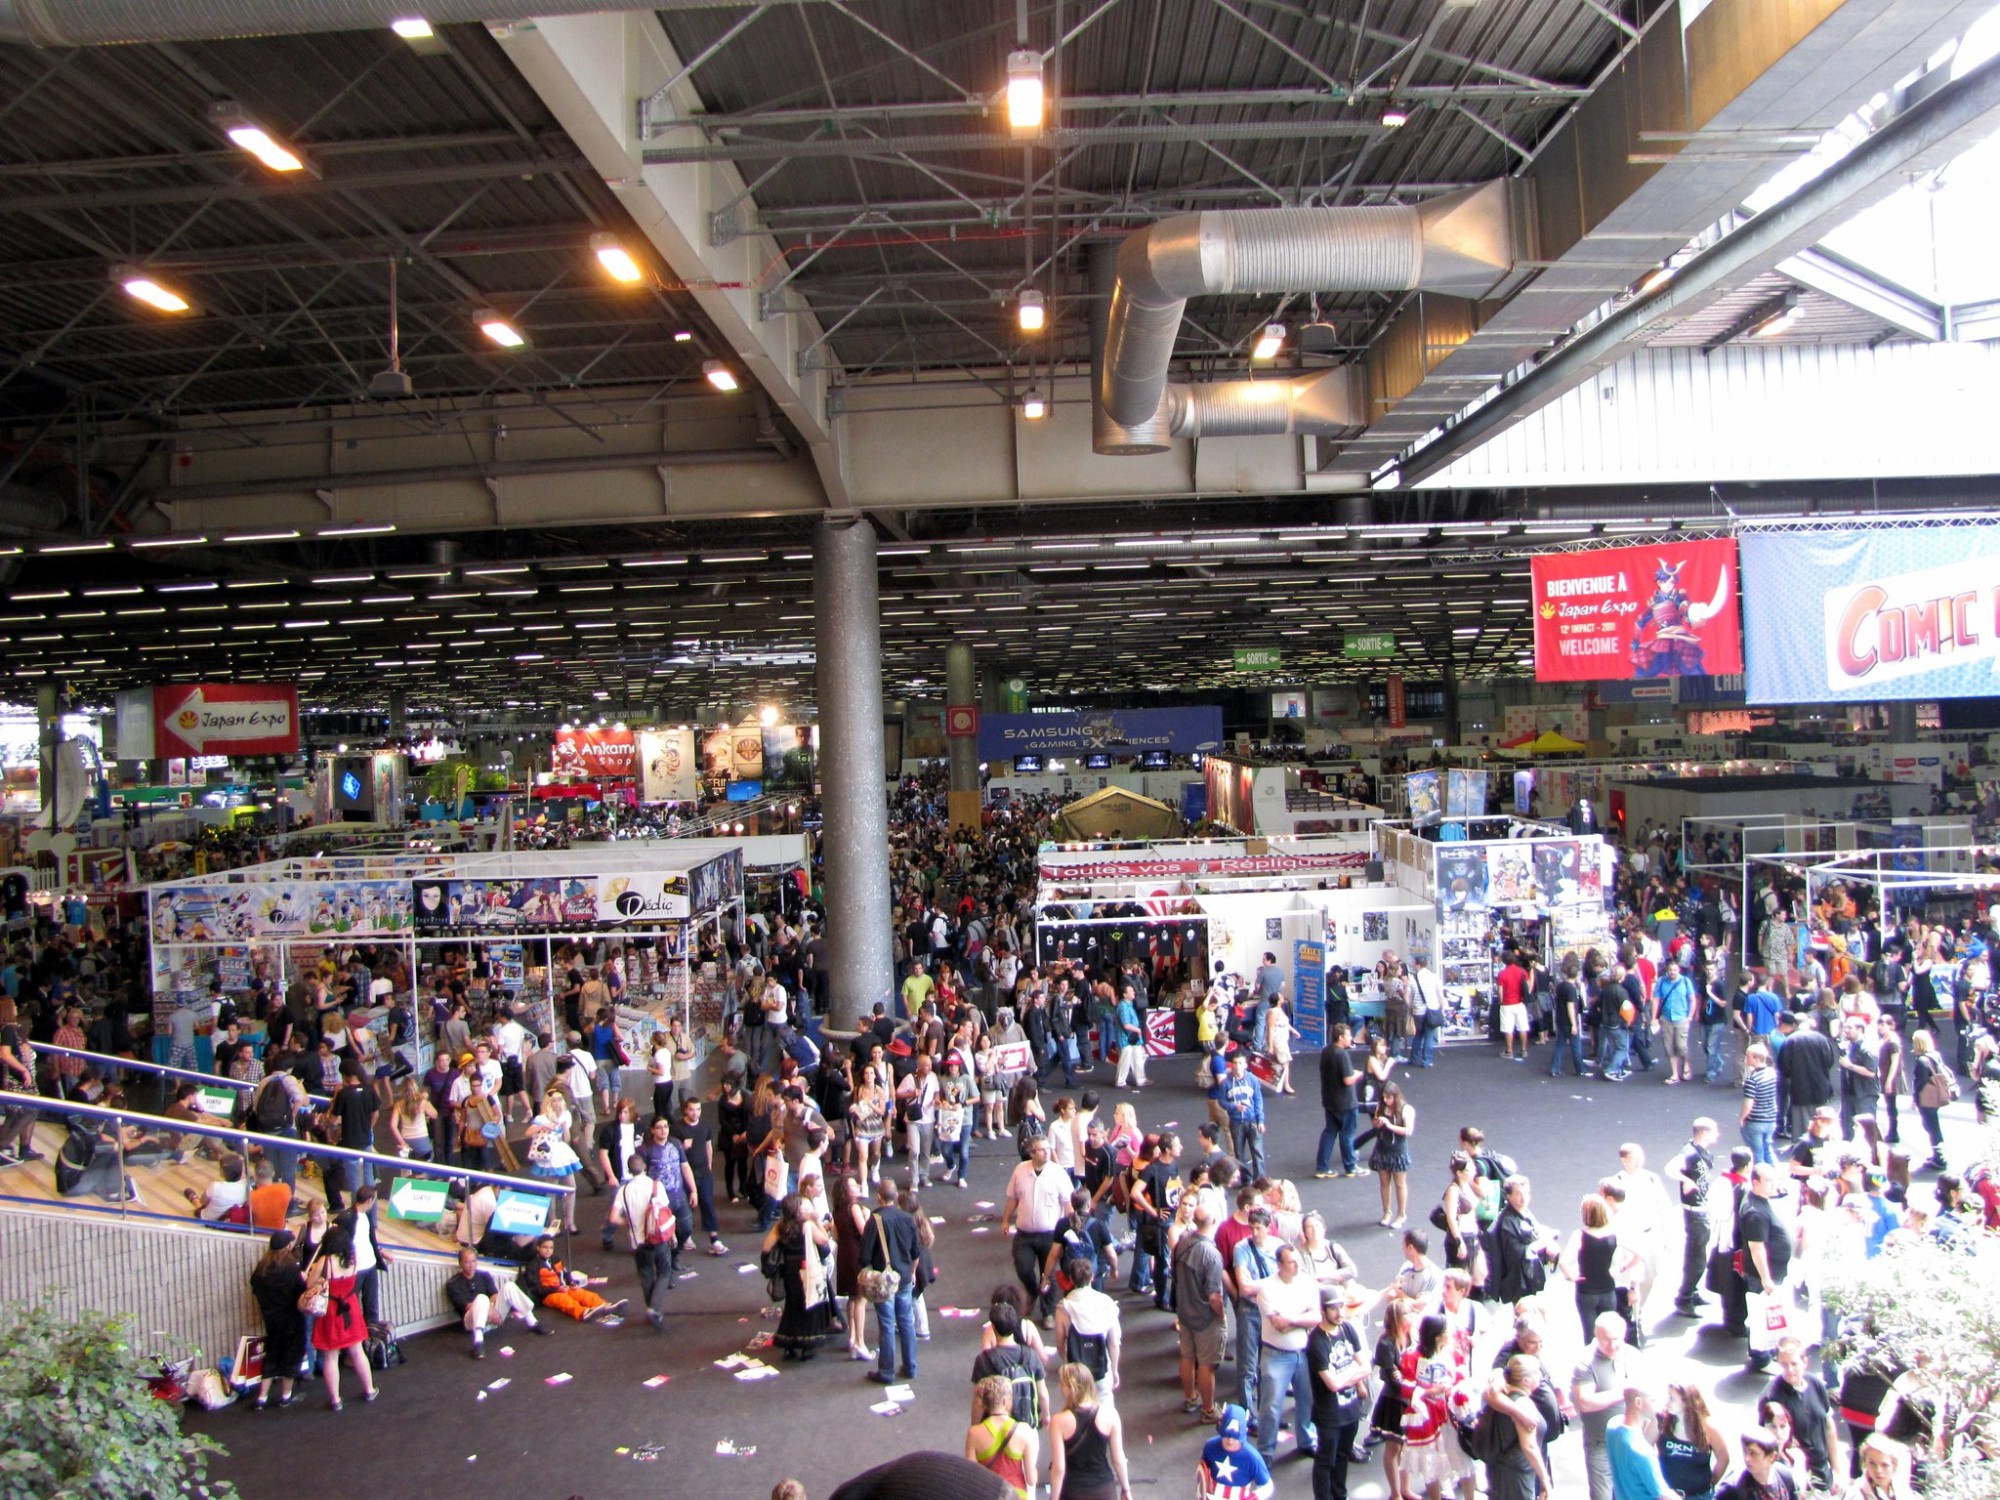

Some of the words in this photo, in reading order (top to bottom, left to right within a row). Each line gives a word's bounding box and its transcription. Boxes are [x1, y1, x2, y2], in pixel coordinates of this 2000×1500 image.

[1547, 575, 1616, 597] BIENVENUE
[1618, 572, 1628, 592] À
[1558, 602, 1598, 619] Japan
[1601, 599, 1638, 616] Expo
[1571, 623, 1595, 633] IMPACT
[1838, 585, 1979, 677] COMIC
[1358, 637, 1382, 651] SORTIE
[1559, 637, 1620, 656] WELCOME
[1246, 652, 1269, 665] SORTIE
[202, 711, 244, 729] Japan
[249, 711, 286, 727] Expo
[1004, 726, 1093, 738] SAMSUNG
[1030, 739, 1077, 748] GAMING
[600, 757, 632, 766] Shop
[1048, 865, 1131, 877] Toutes
[1139, 863, 1182, 873] vos
[1221, 857, 1368, 870] Répliques.co
[611, 893, 673, 924] Dédic
